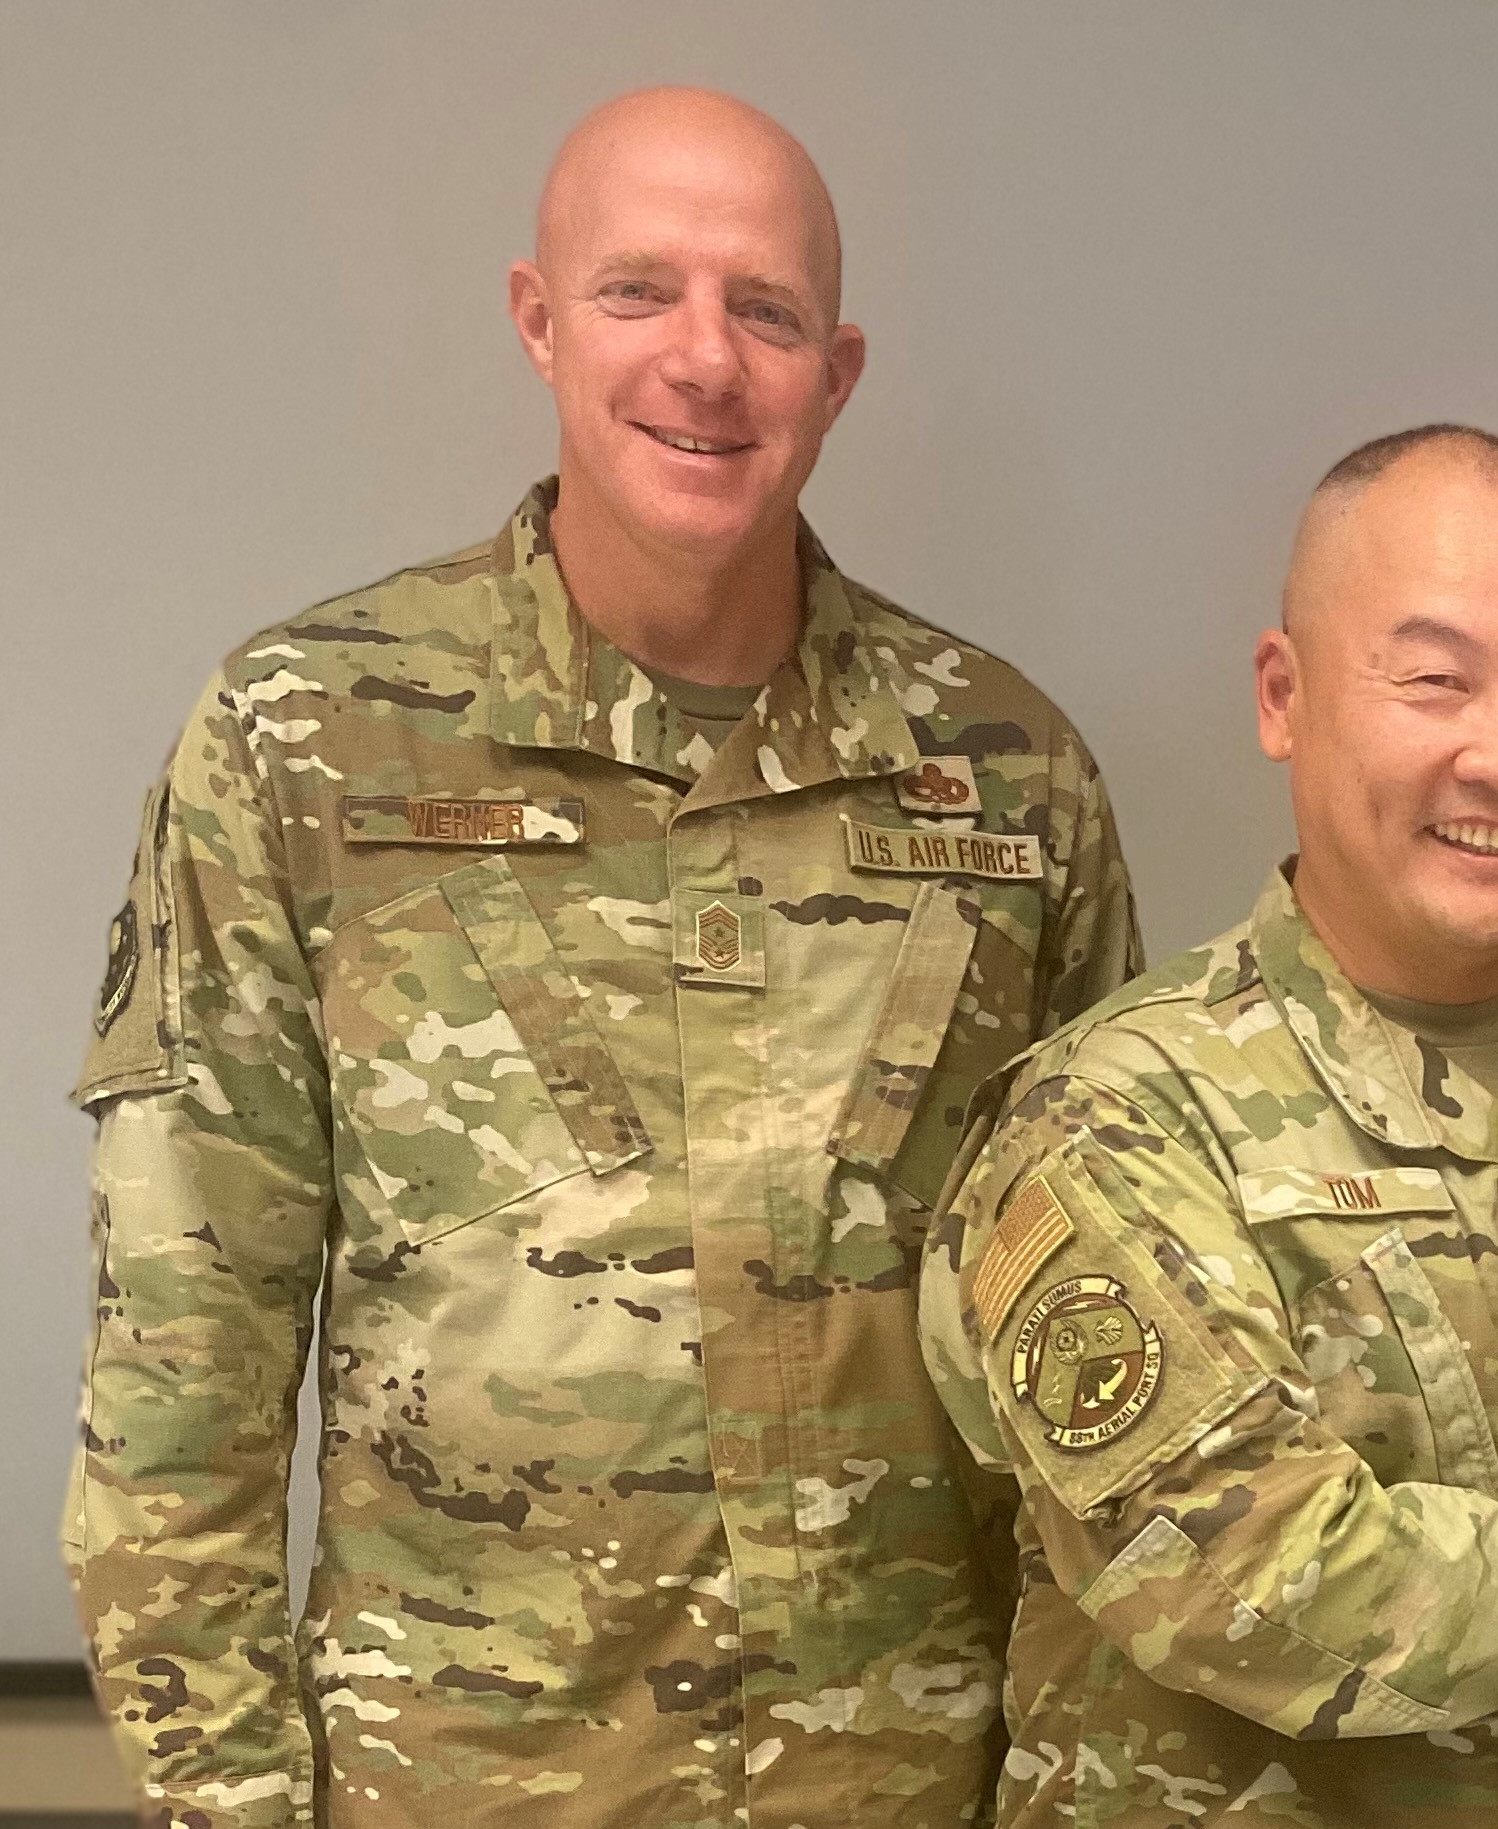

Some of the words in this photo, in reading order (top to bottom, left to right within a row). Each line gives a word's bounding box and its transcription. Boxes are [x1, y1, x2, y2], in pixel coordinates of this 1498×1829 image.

[859, 830, 900, 866] U.S.
[907, 836, 950, 867] AIR
[954, 836, 1031, 874] FORCE
[1321, 1176, 1382, 1209] TOM
[1017, 1303, 1045, 1354] PARATI
[1043, 1281, 1083, 1311] SUMUS
[1098, 1407, 1137, 1440] AERIAL
[1132, 1372, 1157, 1408] PORT
